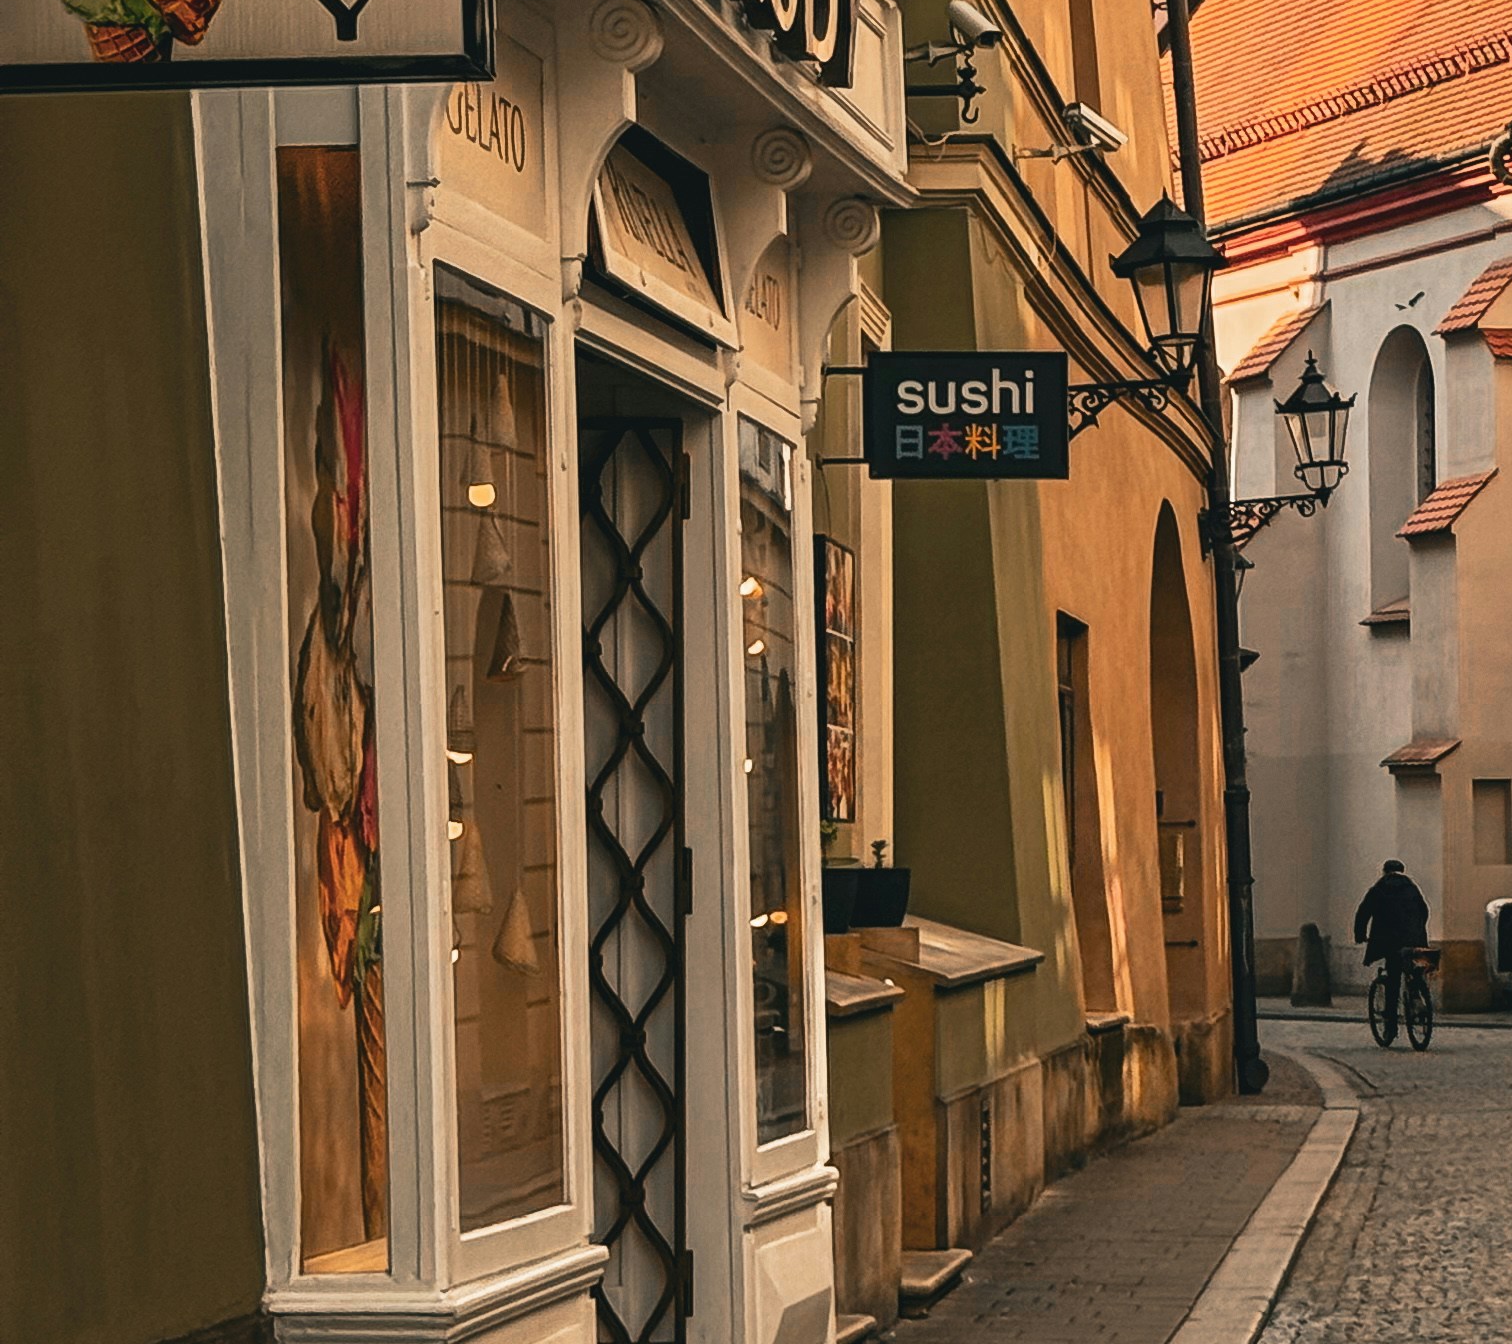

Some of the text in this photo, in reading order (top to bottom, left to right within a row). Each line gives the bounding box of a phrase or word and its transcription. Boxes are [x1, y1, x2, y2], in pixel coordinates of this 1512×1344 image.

[745, 273, 780, 331] ELATO
[897, 368, 1034, 414] sushi
[896, 423, 1040, 460] 日本料理
